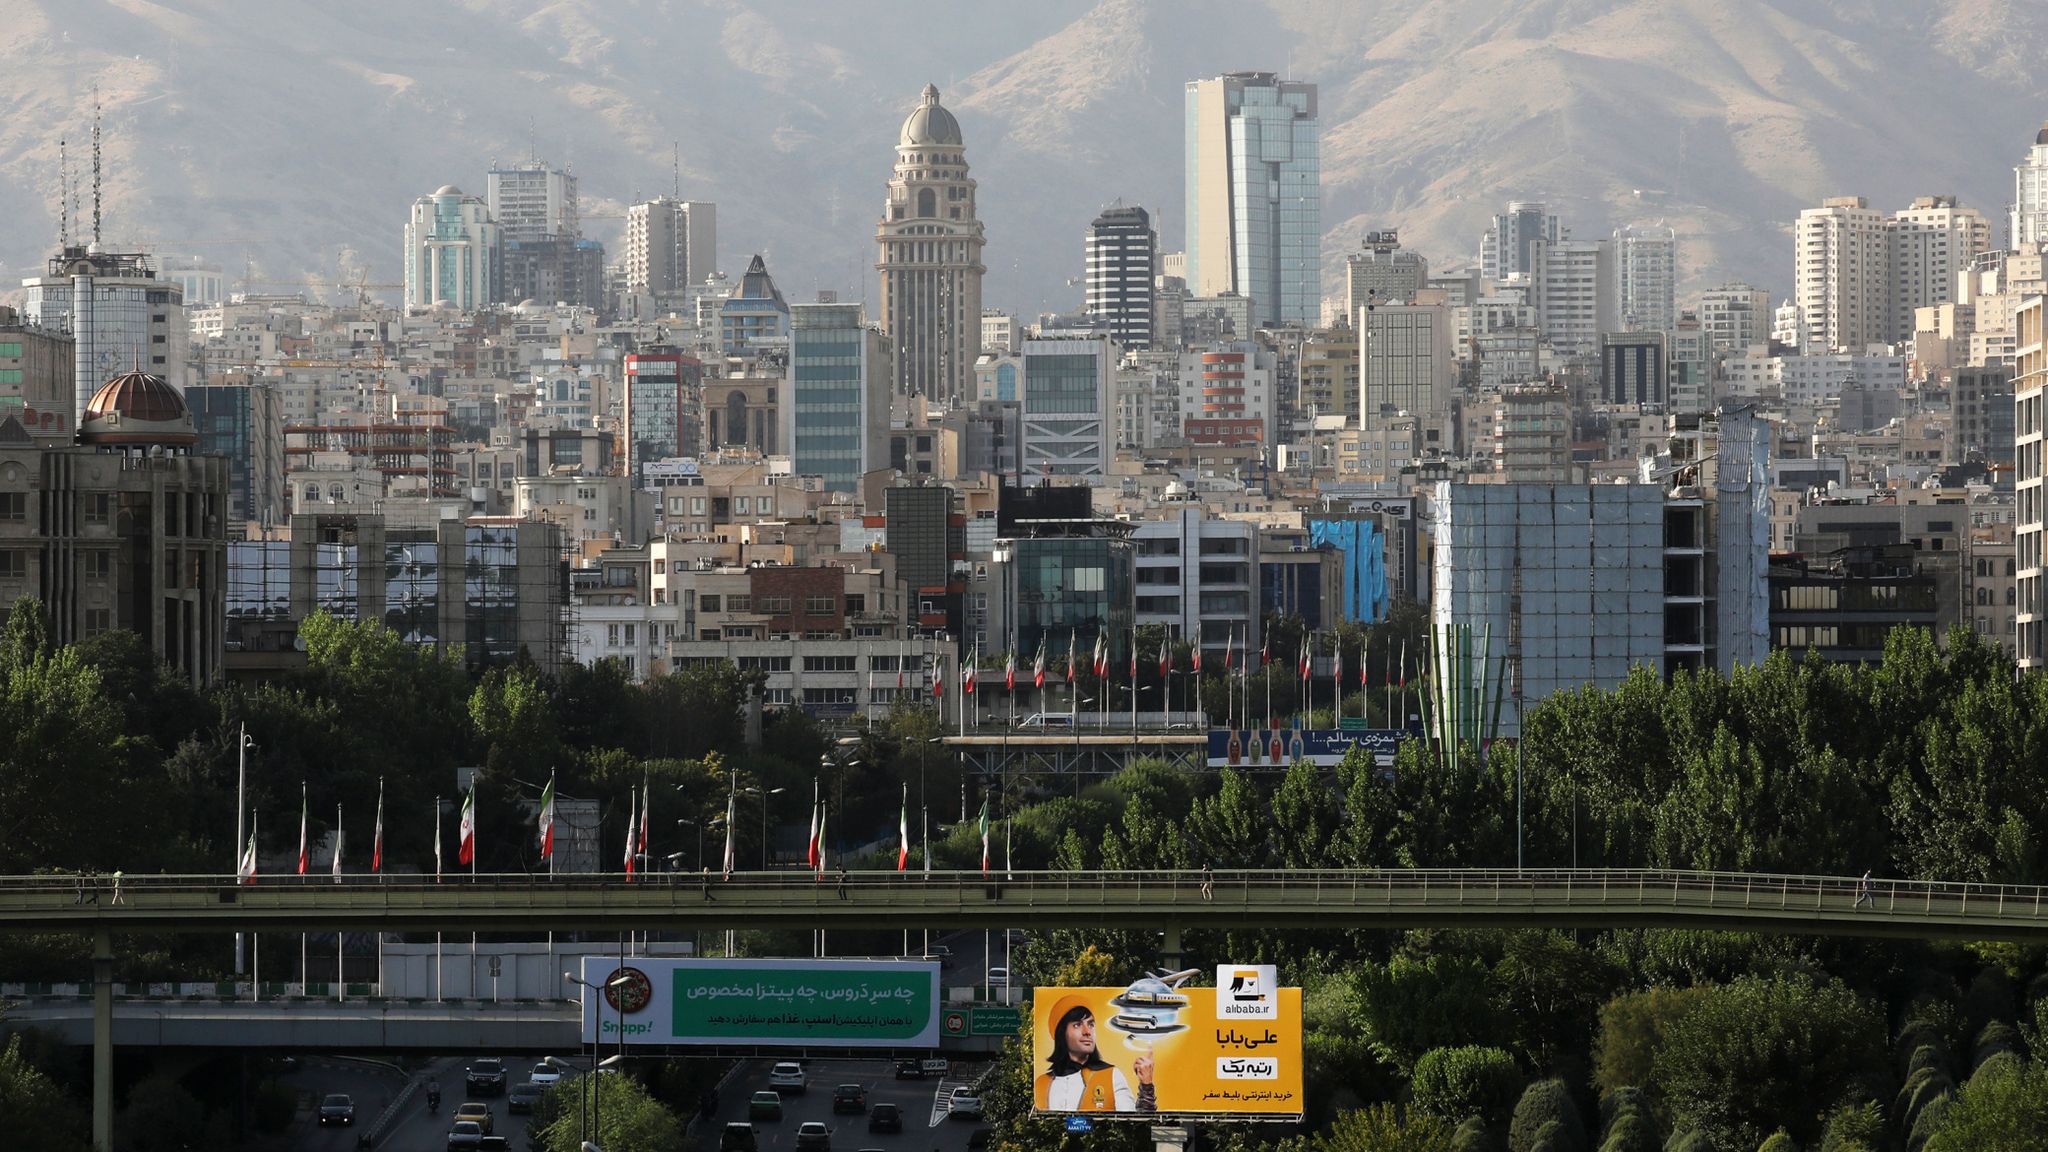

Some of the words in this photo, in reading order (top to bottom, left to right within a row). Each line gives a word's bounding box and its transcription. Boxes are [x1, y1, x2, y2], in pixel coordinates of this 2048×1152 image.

[687, 984, 754, 1000] مخصوص
[756, 983, 795, 1004] پیتزا
[796, 985, 818, 1004] چه
[894, 986, 915, 1005] چه
[1225, 1004, 1270, 1014] alibaba.ir
[708, 1015, 730, 1026] دهید
[732, 1014, 766, 1026] سفارش
[602, 1020, 653, 1035] Snapp!
[1222, 1059, 1246, 1078] یک
[1246, 1062, 1273, 1077] رتبه
[1202, 1089, 1221, 1101] سفر
[1222, 1091, 1241, 1101] بلیط
[1242, 1091, 1272, 1102] اینترنتی
[1273, 1091, 1293, 1102] خرید
